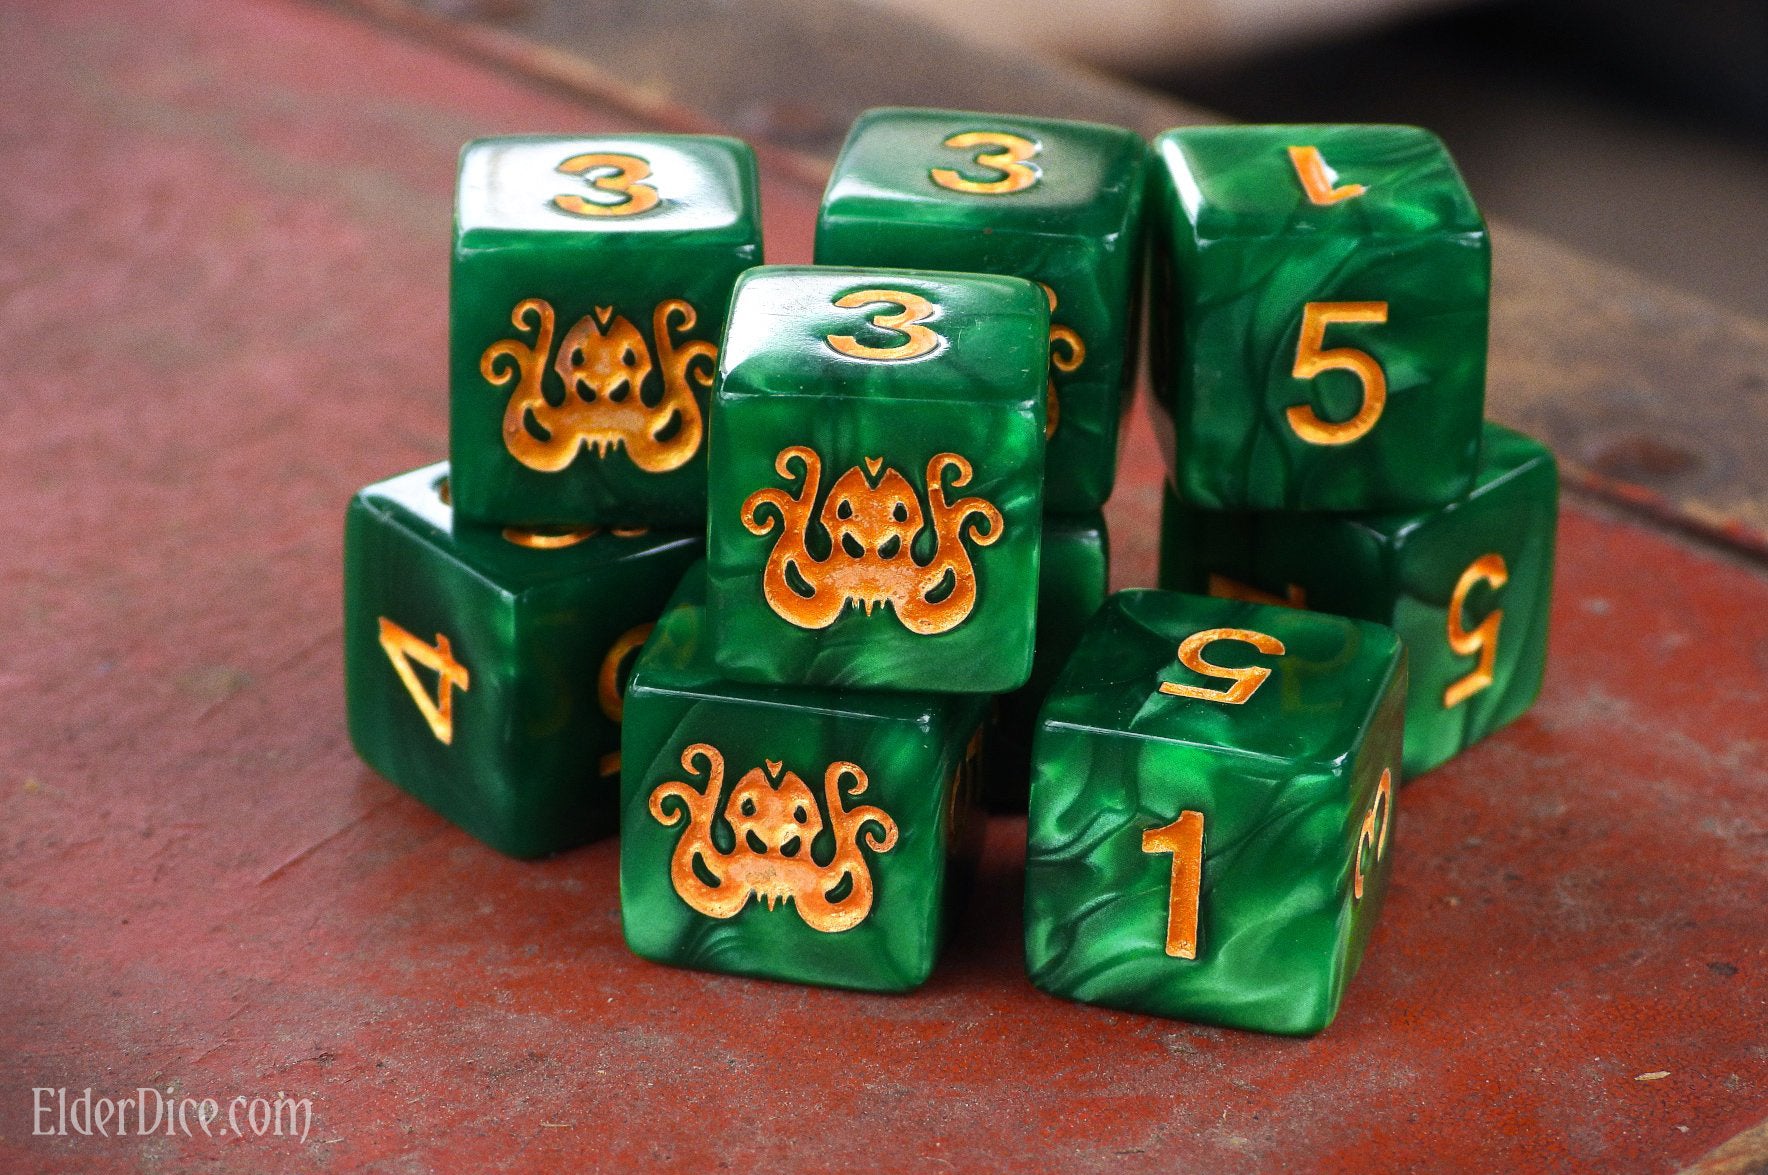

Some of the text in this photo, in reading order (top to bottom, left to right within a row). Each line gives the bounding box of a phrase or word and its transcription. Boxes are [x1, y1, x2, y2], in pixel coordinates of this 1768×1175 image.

[554, 153, 661, 216] 3
[931, 132, 1041, 194] 3
[826, 290, 942, 361] 3
[1286, 302, 1389, 447] 5
[378, 616, 470, 745] 4
[1159, 628, 1286, 705] 5
[1444, 554, 1508, 709] 5
[1141, 810, 1205, 960] 1
